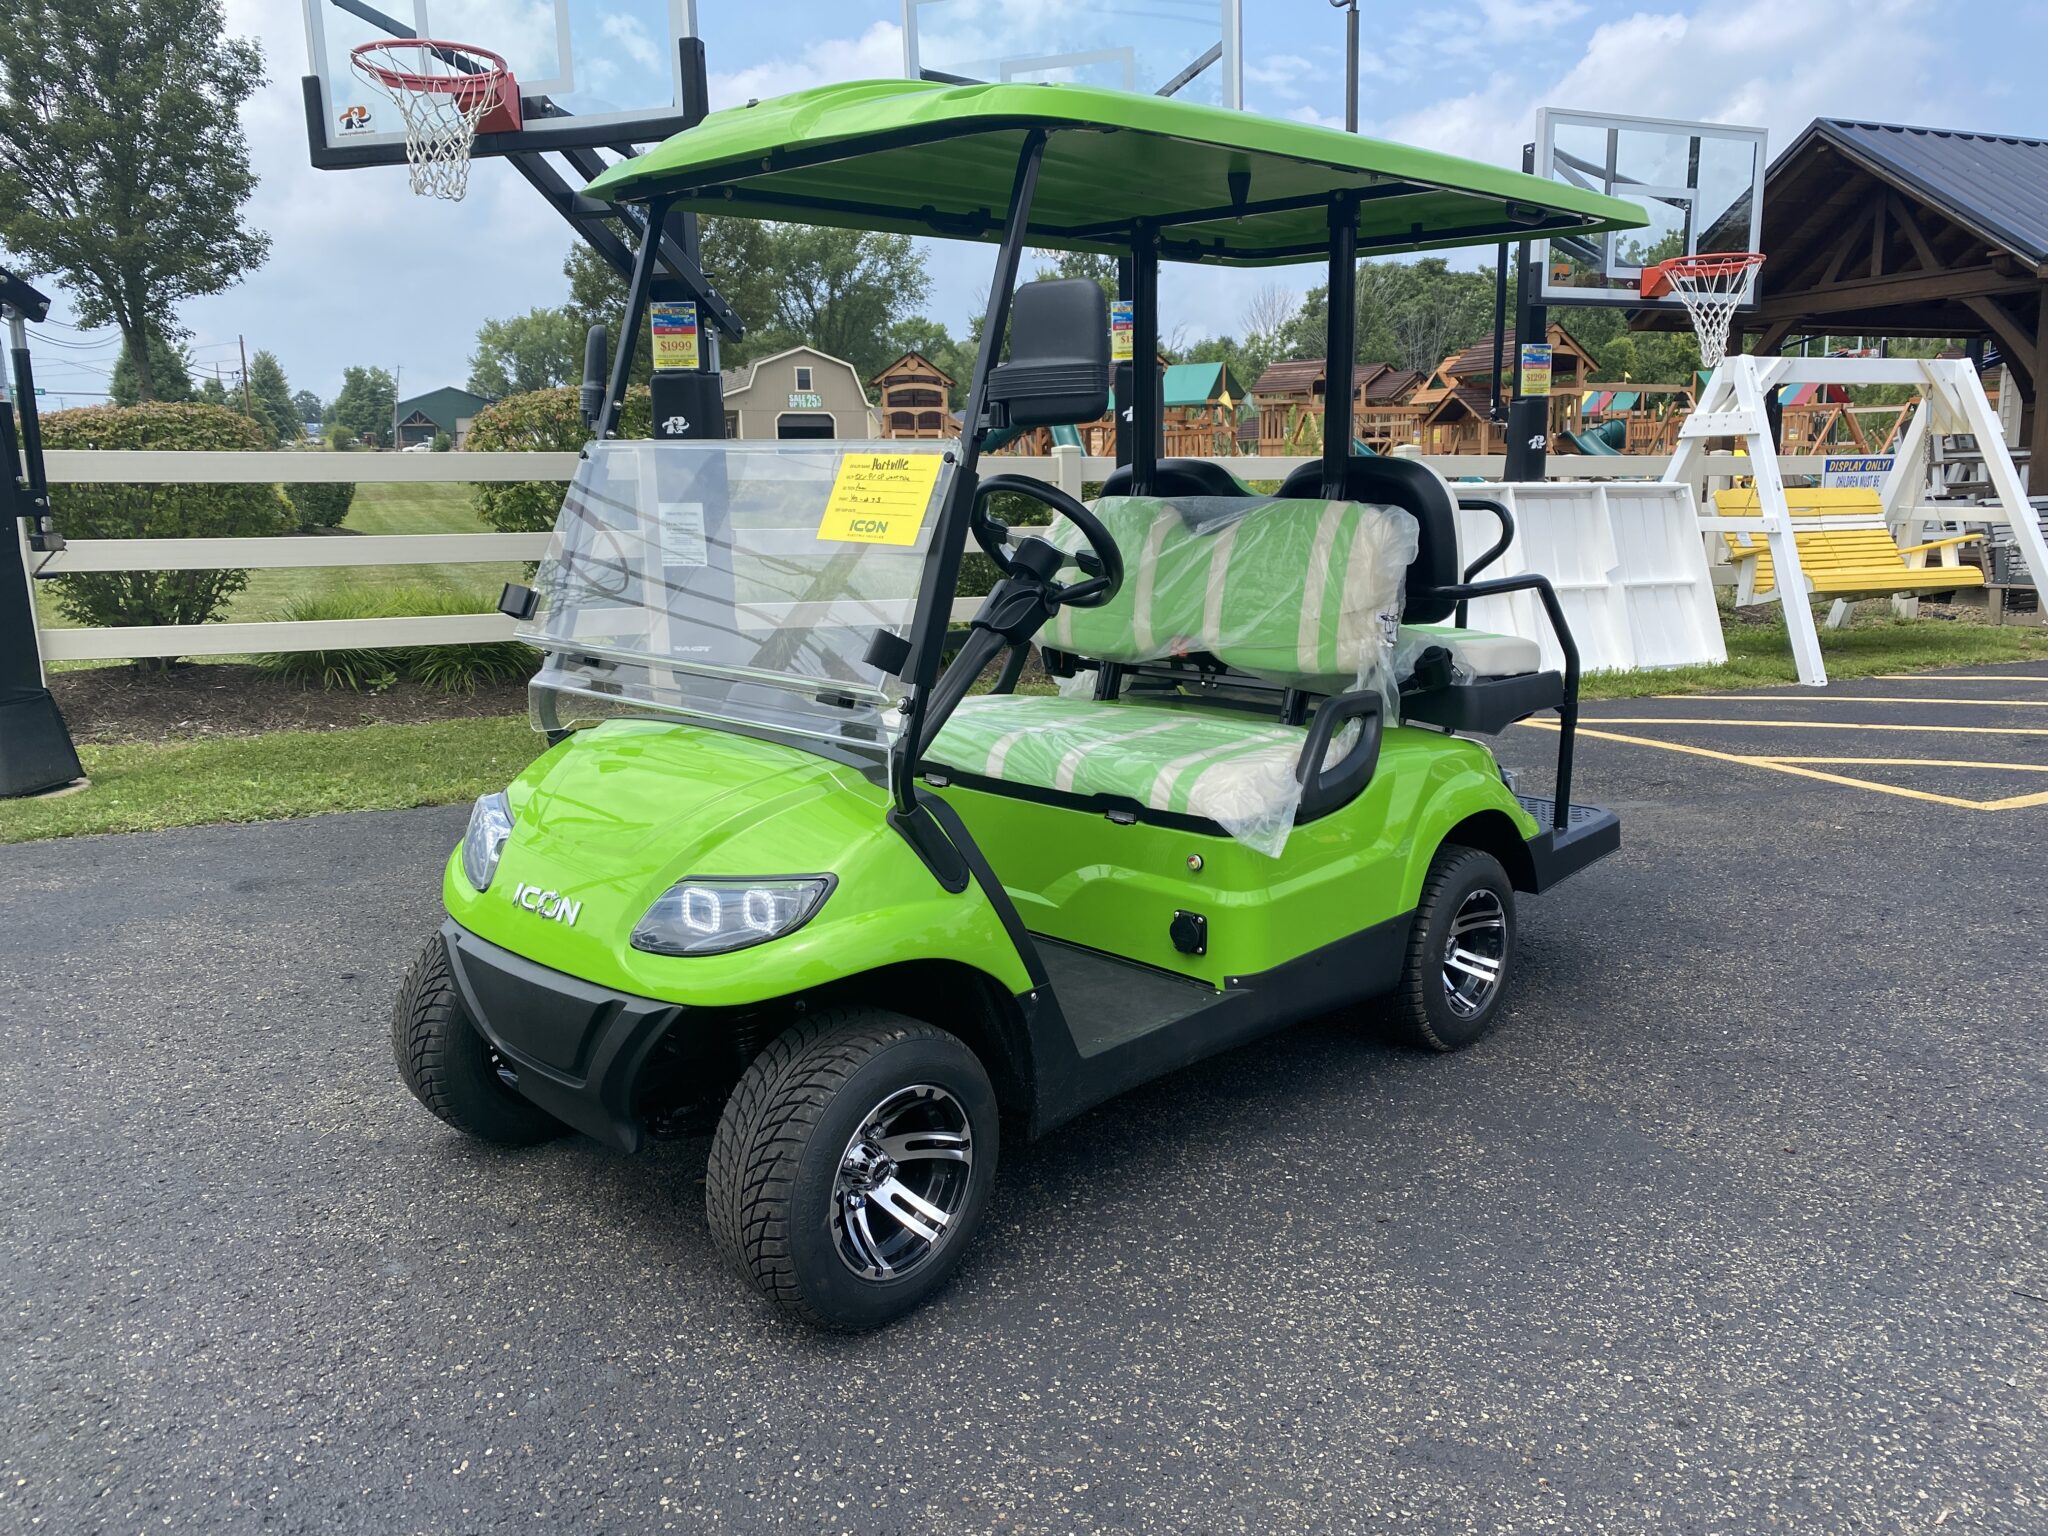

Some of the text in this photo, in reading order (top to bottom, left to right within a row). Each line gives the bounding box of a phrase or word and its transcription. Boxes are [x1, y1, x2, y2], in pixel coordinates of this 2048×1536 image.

[660, 341, 692, 352] $1999
[789, 394, 806, 402] SALE
[1829, 460, 1891, 472] DISPLAY ONLY!
[1836, 475, 1880, 488] CHILDREN MUST BE
[849, 520, 888, 533] ICON
[512, 881, 583, 928] ICON
